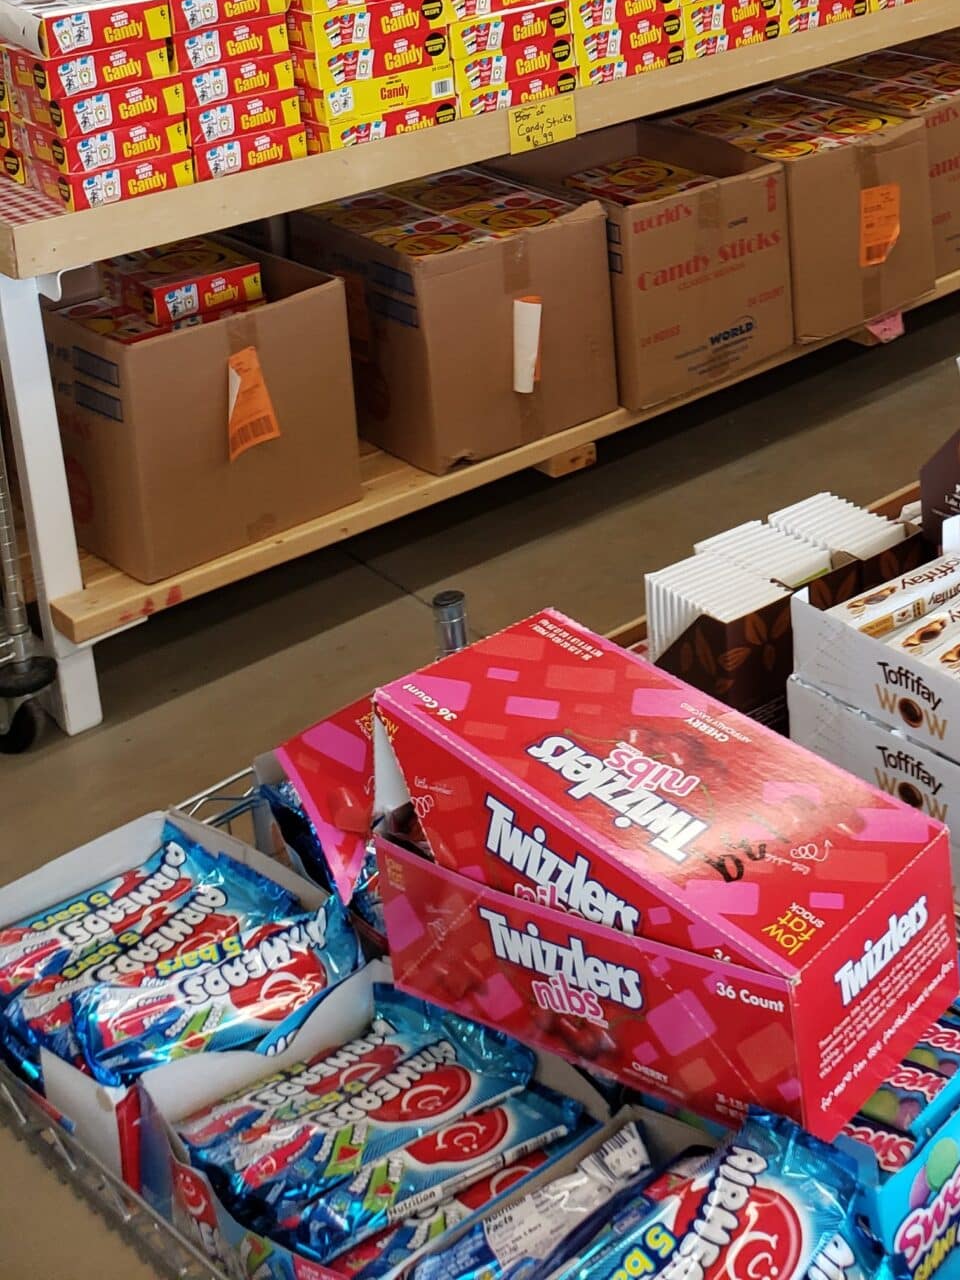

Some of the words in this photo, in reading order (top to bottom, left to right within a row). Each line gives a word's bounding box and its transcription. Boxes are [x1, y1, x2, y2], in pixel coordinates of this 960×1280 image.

[381, 8, 420, 33] Candy
[732, 2, 760, 22] Candy
[104, 18, 143, 44] Candy
[630, 27, 662, 48] Candy
[234, 70, 270, 93] Candy
[380, 82, 410, 100] Candy
[515, 111, 530, 122] Box
[536, 105, 546, 116] of
[518, 122, 544, 136] Candy
[546, 114, 572, 128] Sticks
[123, 134, 161, 158] Candy
[248, 142, 283, 166] Candy
[637, 254, 710, 291] Candy
[718, 230, 781, 261] Sticks
[205, 284, 238, 306] Candy
[710, 321, 754, 345] WORLD
[402, 682, 439, 712] Count
[876, 661, 943, 710] Toffifay
[439, 705, 458, 722] 36
[686, 716, 730, 743] CHERRY
[604, 746, 701, 797] nibs
[526, 734, 709, 864] Twizzlers
[482, 792, 641, 938] Twizzlers
[59, 840, 187, 946] AIRHEADS
[778, 910, 817, 942] fat
[789, 901, 826, 928] snack
[94, 886, 227, 982] AIRHEADS
[119, 931, 142, 946] 5
[224, 936, 245, 956] 5
[760, 924, 806, 956] low
[62, 942, 122, 980] bars
[155, 945, 230, 977] bars
[185, 907, 329, 1007] AIRHEADS
[479, 905, 644, 1011] Twizzlers
[834, 895, 928, 1007] Twizzlers
[532, 976, 604, 1020] nibs
[715, 981, 736, 998] 36
[740, 986, 785, 1014] Count
[632, 1060, 670, 1084] CHERRY
[387, 1189, 438, 1219] Nutrition
